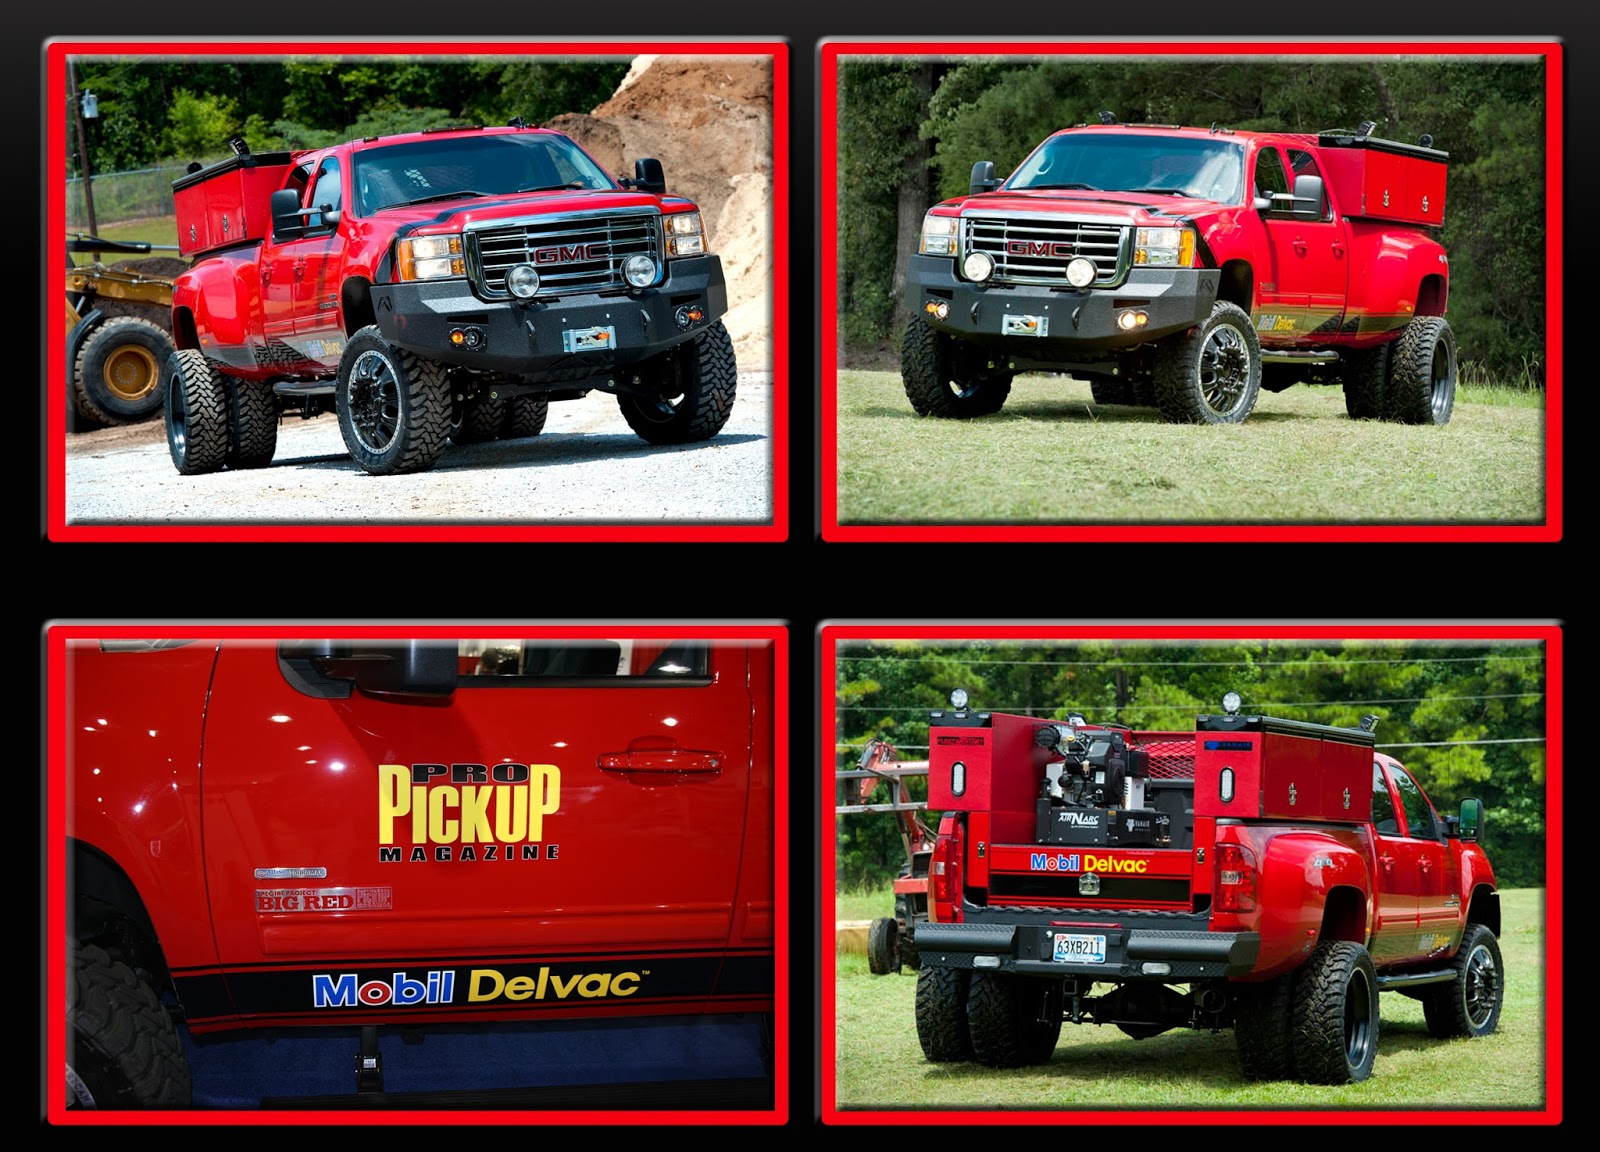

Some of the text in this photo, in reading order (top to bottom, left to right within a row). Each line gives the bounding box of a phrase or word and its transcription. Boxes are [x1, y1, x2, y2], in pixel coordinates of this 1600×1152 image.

[534, 242, 610, 265] GMC
[1006, 240, 1074, 258] GMC
[411, 763, 529, 784] PRO
[378, 763, 561, 845] PICKUP
[379, 844, 559, 863] MAGAZINE
[1031, 853, 1148, 873] Mobil Delvac
[257, 895, 354, 911] BIG RED
[1056, 940, 1100, 955] 63XB211
[312, 970, 456, 1008] Mobil
[468, 967, 640, 1003] Delvac
